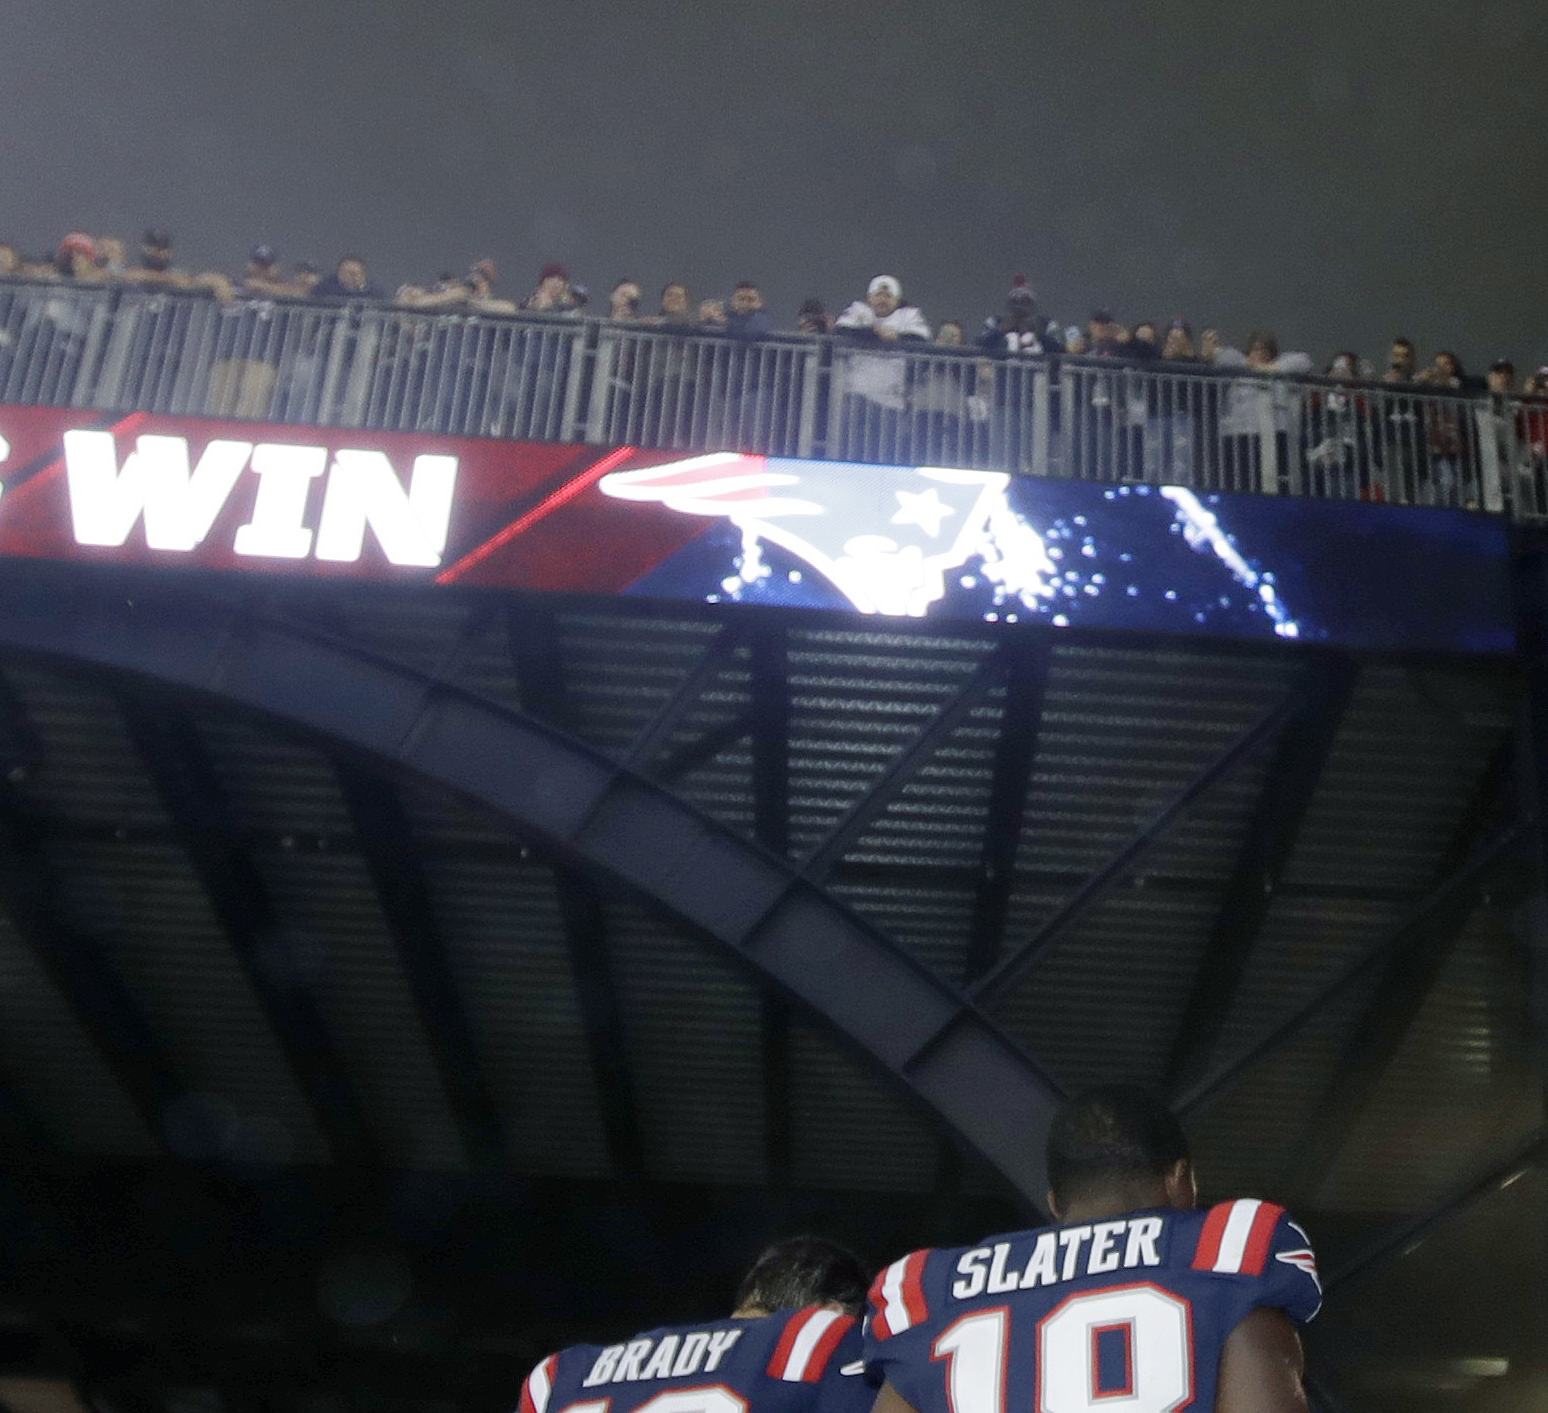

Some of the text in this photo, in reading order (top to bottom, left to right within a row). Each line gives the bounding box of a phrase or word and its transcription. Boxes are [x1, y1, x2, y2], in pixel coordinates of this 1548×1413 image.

[62, 428, 459, 567] WIN
[952, 1216, 1164, 1300] SLATER
[582, 1328, 744, 1388] BRADY
